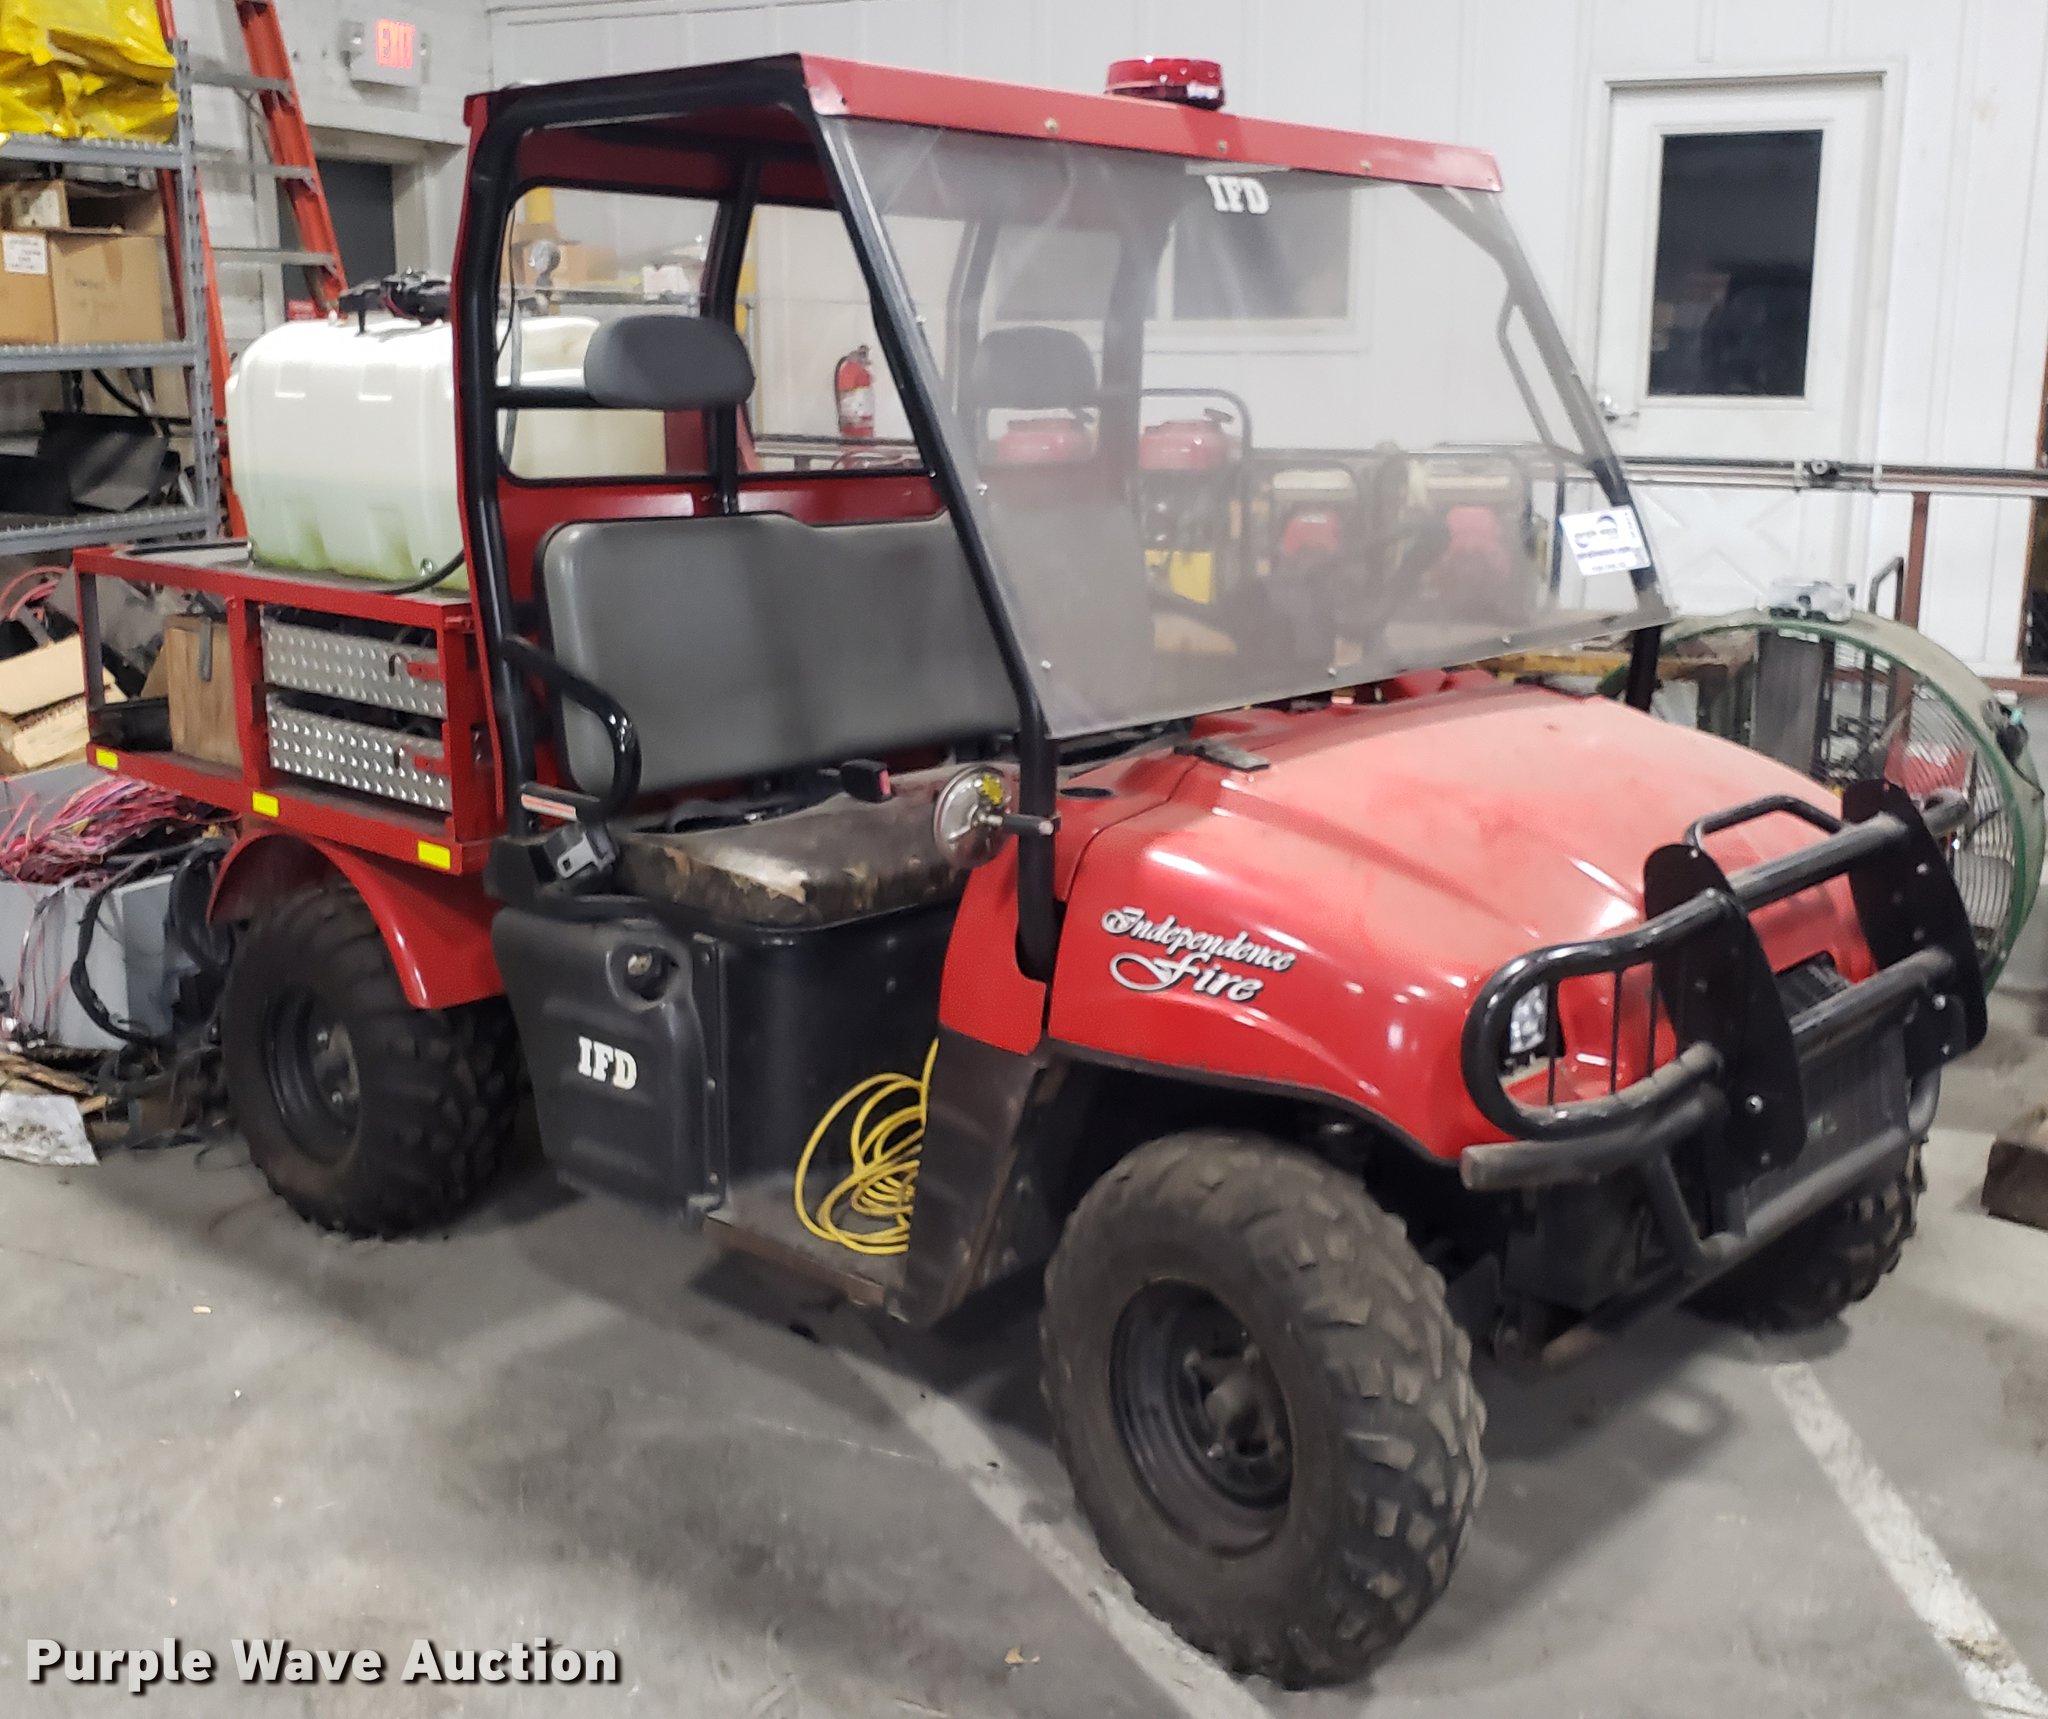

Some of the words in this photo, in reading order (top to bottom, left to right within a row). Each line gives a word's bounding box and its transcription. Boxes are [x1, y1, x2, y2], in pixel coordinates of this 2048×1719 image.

[376, 19, 416, 69] EXIT
[1205, 174, 1269, 214] IFD
[1101, 906, 1296, 971] Independence
[1109, 952, 1264, 1001] Fire
[578, 1035, 637, 1090] IFD
